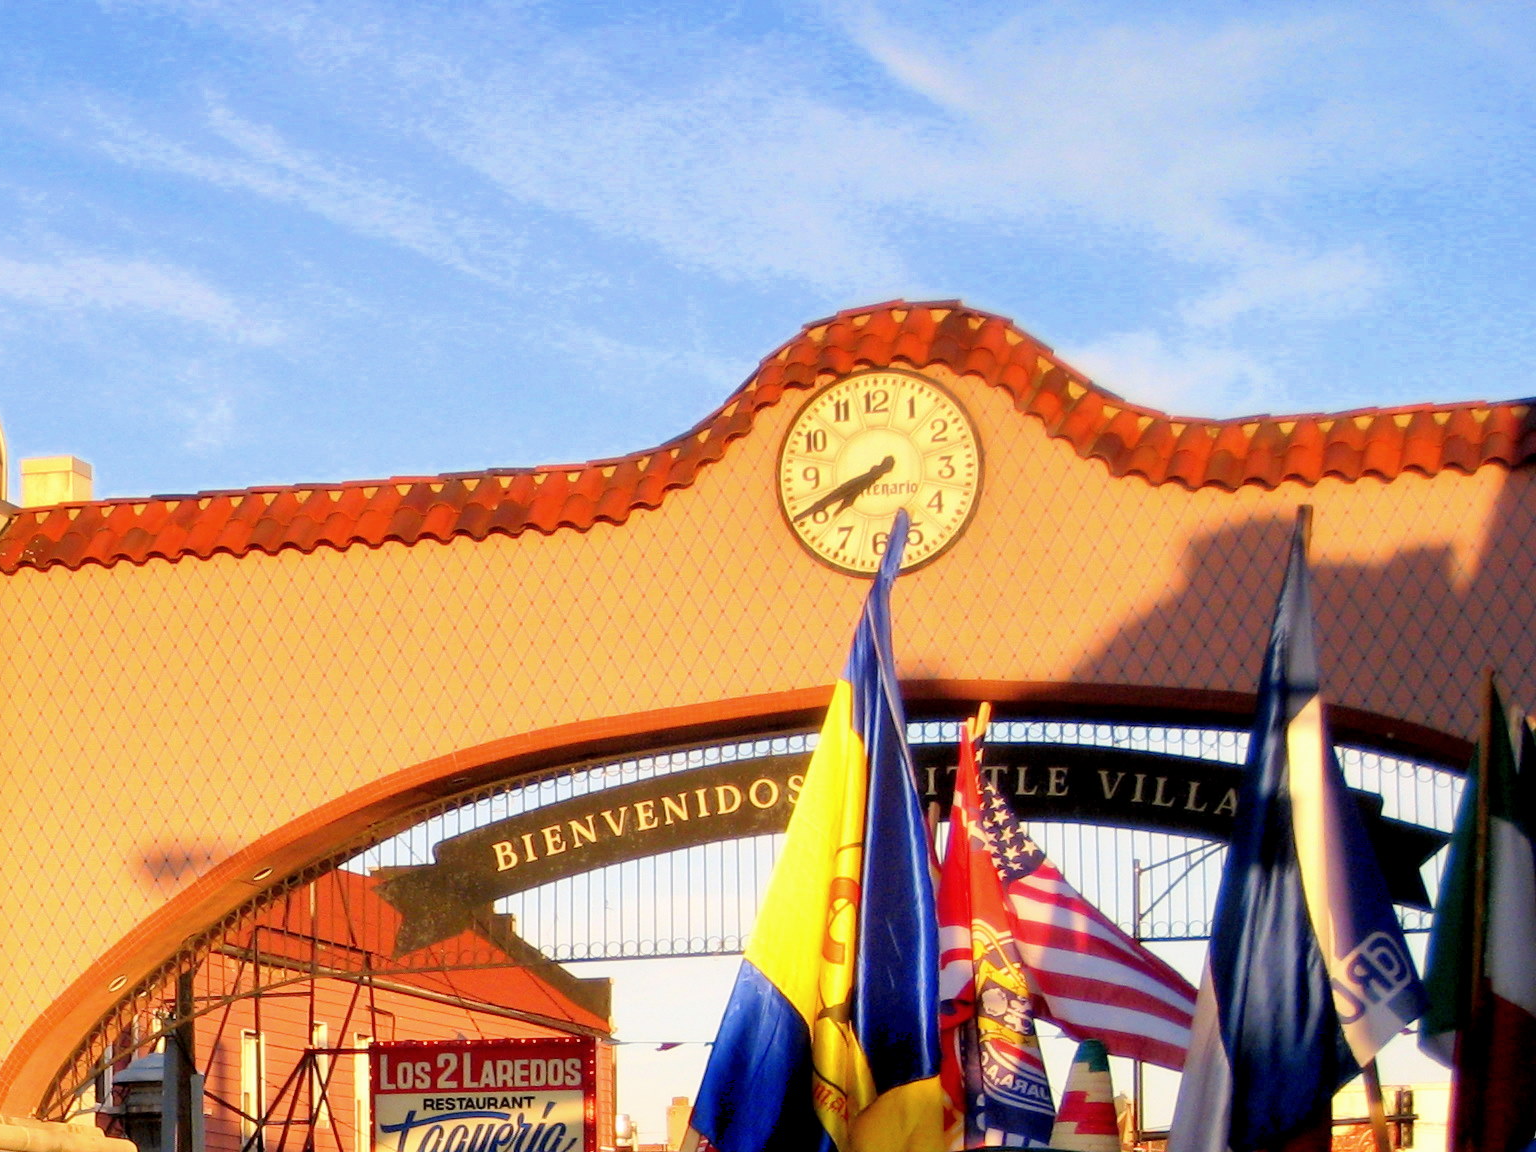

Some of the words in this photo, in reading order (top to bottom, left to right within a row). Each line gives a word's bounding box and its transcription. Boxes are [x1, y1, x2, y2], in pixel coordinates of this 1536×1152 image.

[834, 399, 850, 422] 11
[864, 389, 889, 413] 12
[907, 396, 915, 419] 1
[805, 429, 827, 454] 10
[930, 418, 948, 442] 2
[802, 466, 820, 490] 9
[938, 455, 955, 479] 3
[864, 480, 918, 497] tenario
[927, 490, 944, 513] 4
[837, 526, 854, 549] 7
[872, 532, 890, 555] 6
[907, 521, 924, 546] 5
[492, 775, 805, 872] BIENVENIDOS
[925, 765, 1069, 796] ITLE
[1097, 769, 1239, 818] VILLA
[379, 1053, 431, 1090] LOS
[436, 1053, 458, 1088] 2
[463, 1051, 582, 1088] LAREDOS
[423, 1096, 535, 1111] RESTAURANT
